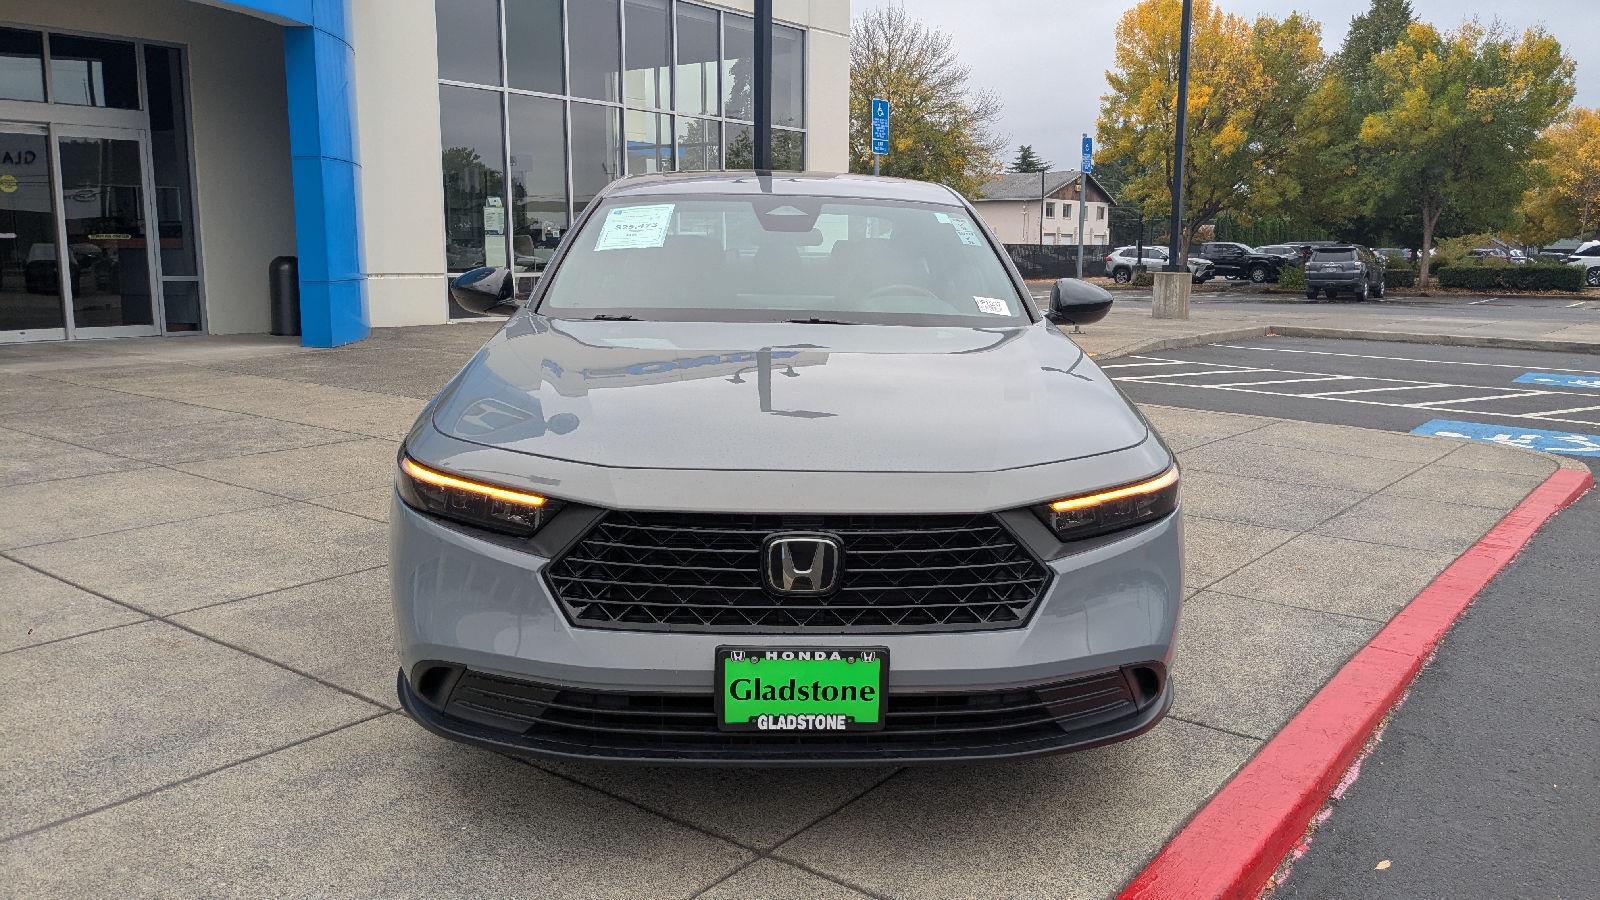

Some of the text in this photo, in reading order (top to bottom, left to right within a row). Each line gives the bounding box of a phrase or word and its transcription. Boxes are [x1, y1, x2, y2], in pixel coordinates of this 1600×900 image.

[765, 651, 842, 661] HONDA
[729, 677, 876, 701] Gladstone
[757, 714, 846, 730] GLADSTONE
